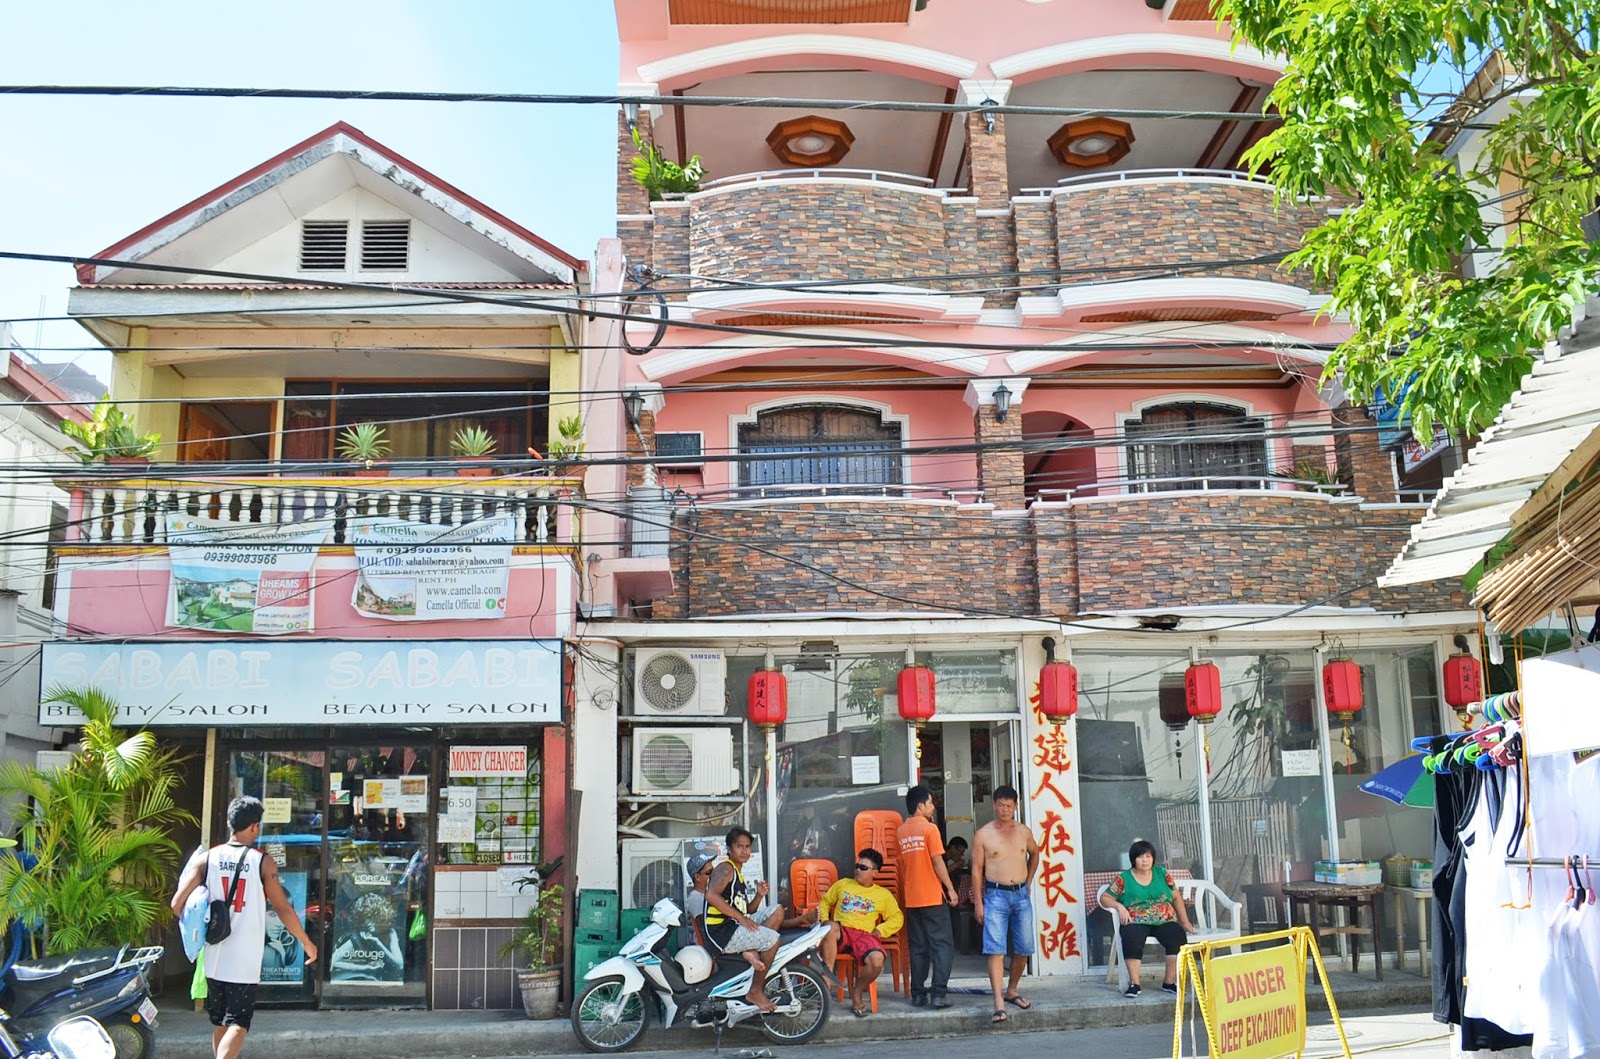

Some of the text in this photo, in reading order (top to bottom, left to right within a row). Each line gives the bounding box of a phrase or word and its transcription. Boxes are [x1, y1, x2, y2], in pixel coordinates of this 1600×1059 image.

[373, 522, 418, 536] Camella
[203, 551, 277, 565] 09399083966
[405, 556, 504, 568] sababiboracay@yahoo.com
[261, 579, 299, 588] DREAMS
[260, 589, 286, 599] GROW
[426, 585, 501, 596] www.camella.com
[426, 599, 481, 610] Camella Official
[53, 649, 272, 690] SABABI
[325, 648, 550, 690] SABABI
[47, 704, 268, 716] BETY SALON
[323, 703, 547, 715] BEAUTY SALON
[451, 750, 526, 771] MONEY CHANGER
[448, 797, 472, 808] 6.50
[475, 853, 501, 863] CLOSED
[219, 861, 250, 873] BARRDO
[1223, 965, 1287, 1004] DANGER
[1220, 1004, 1297, 1055] DEEP EXCAVATION
